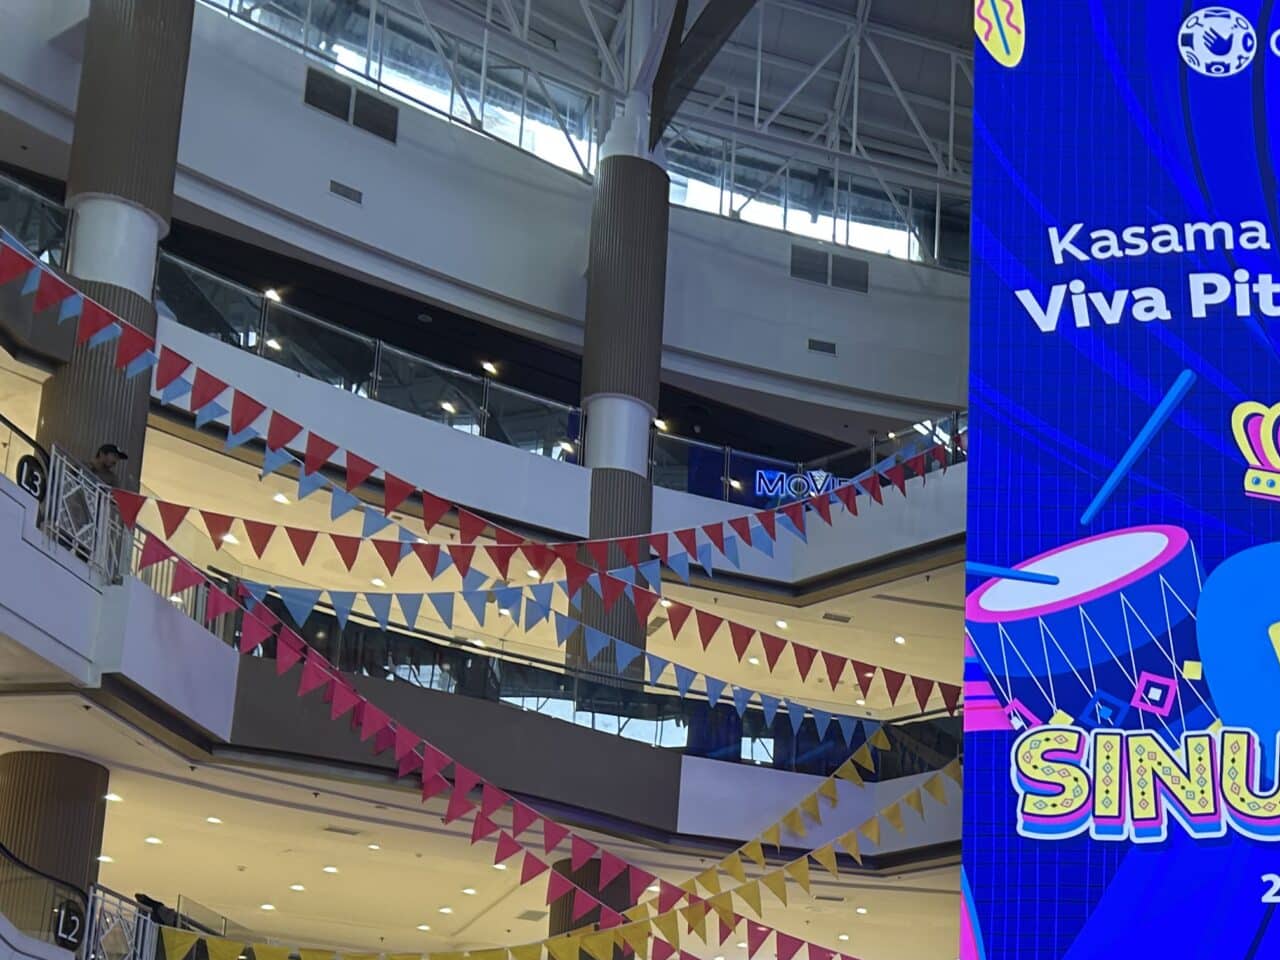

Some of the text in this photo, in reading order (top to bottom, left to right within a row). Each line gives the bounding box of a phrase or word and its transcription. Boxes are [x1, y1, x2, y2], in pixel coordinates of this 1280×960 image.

[1048, 216, 1270, 265] Kasama
[1015, 279, 1171, 333] Viva
[1188, 268, 1280, 318] Pit
[21, 461, 41, 496] L3
[58, 905, 80, 943] L2
